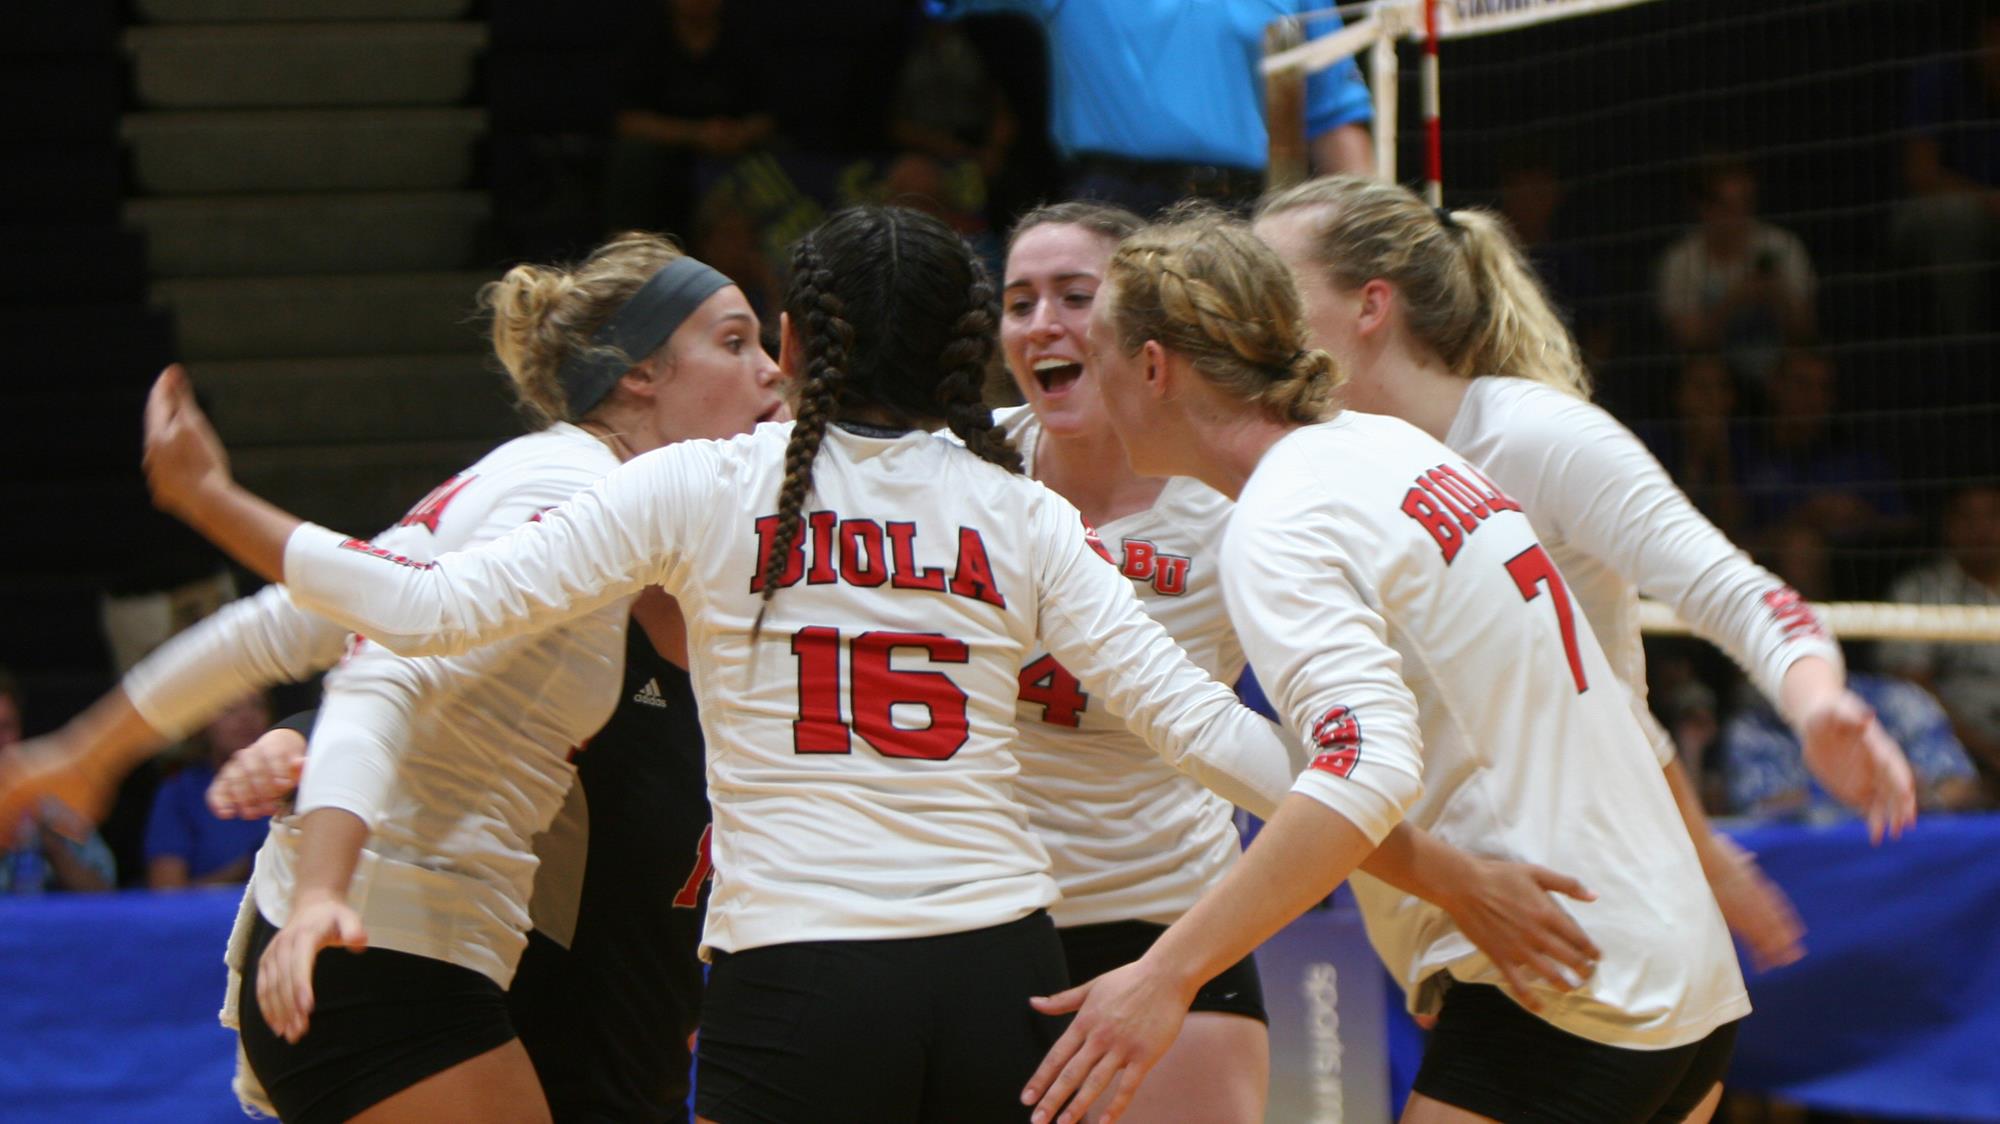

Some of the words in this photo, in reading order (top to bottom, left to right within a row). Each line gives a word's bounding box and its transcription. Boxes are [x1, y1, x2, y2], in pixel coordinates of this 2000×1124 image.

[750, 511, 1006, 610] BIOLA
[1121, 538, 1191, 596] BU
[1504, 543, 1588, 694] 7
[791, 625, 969, 760] 16
[1017, 652, 1088, 728] 4
